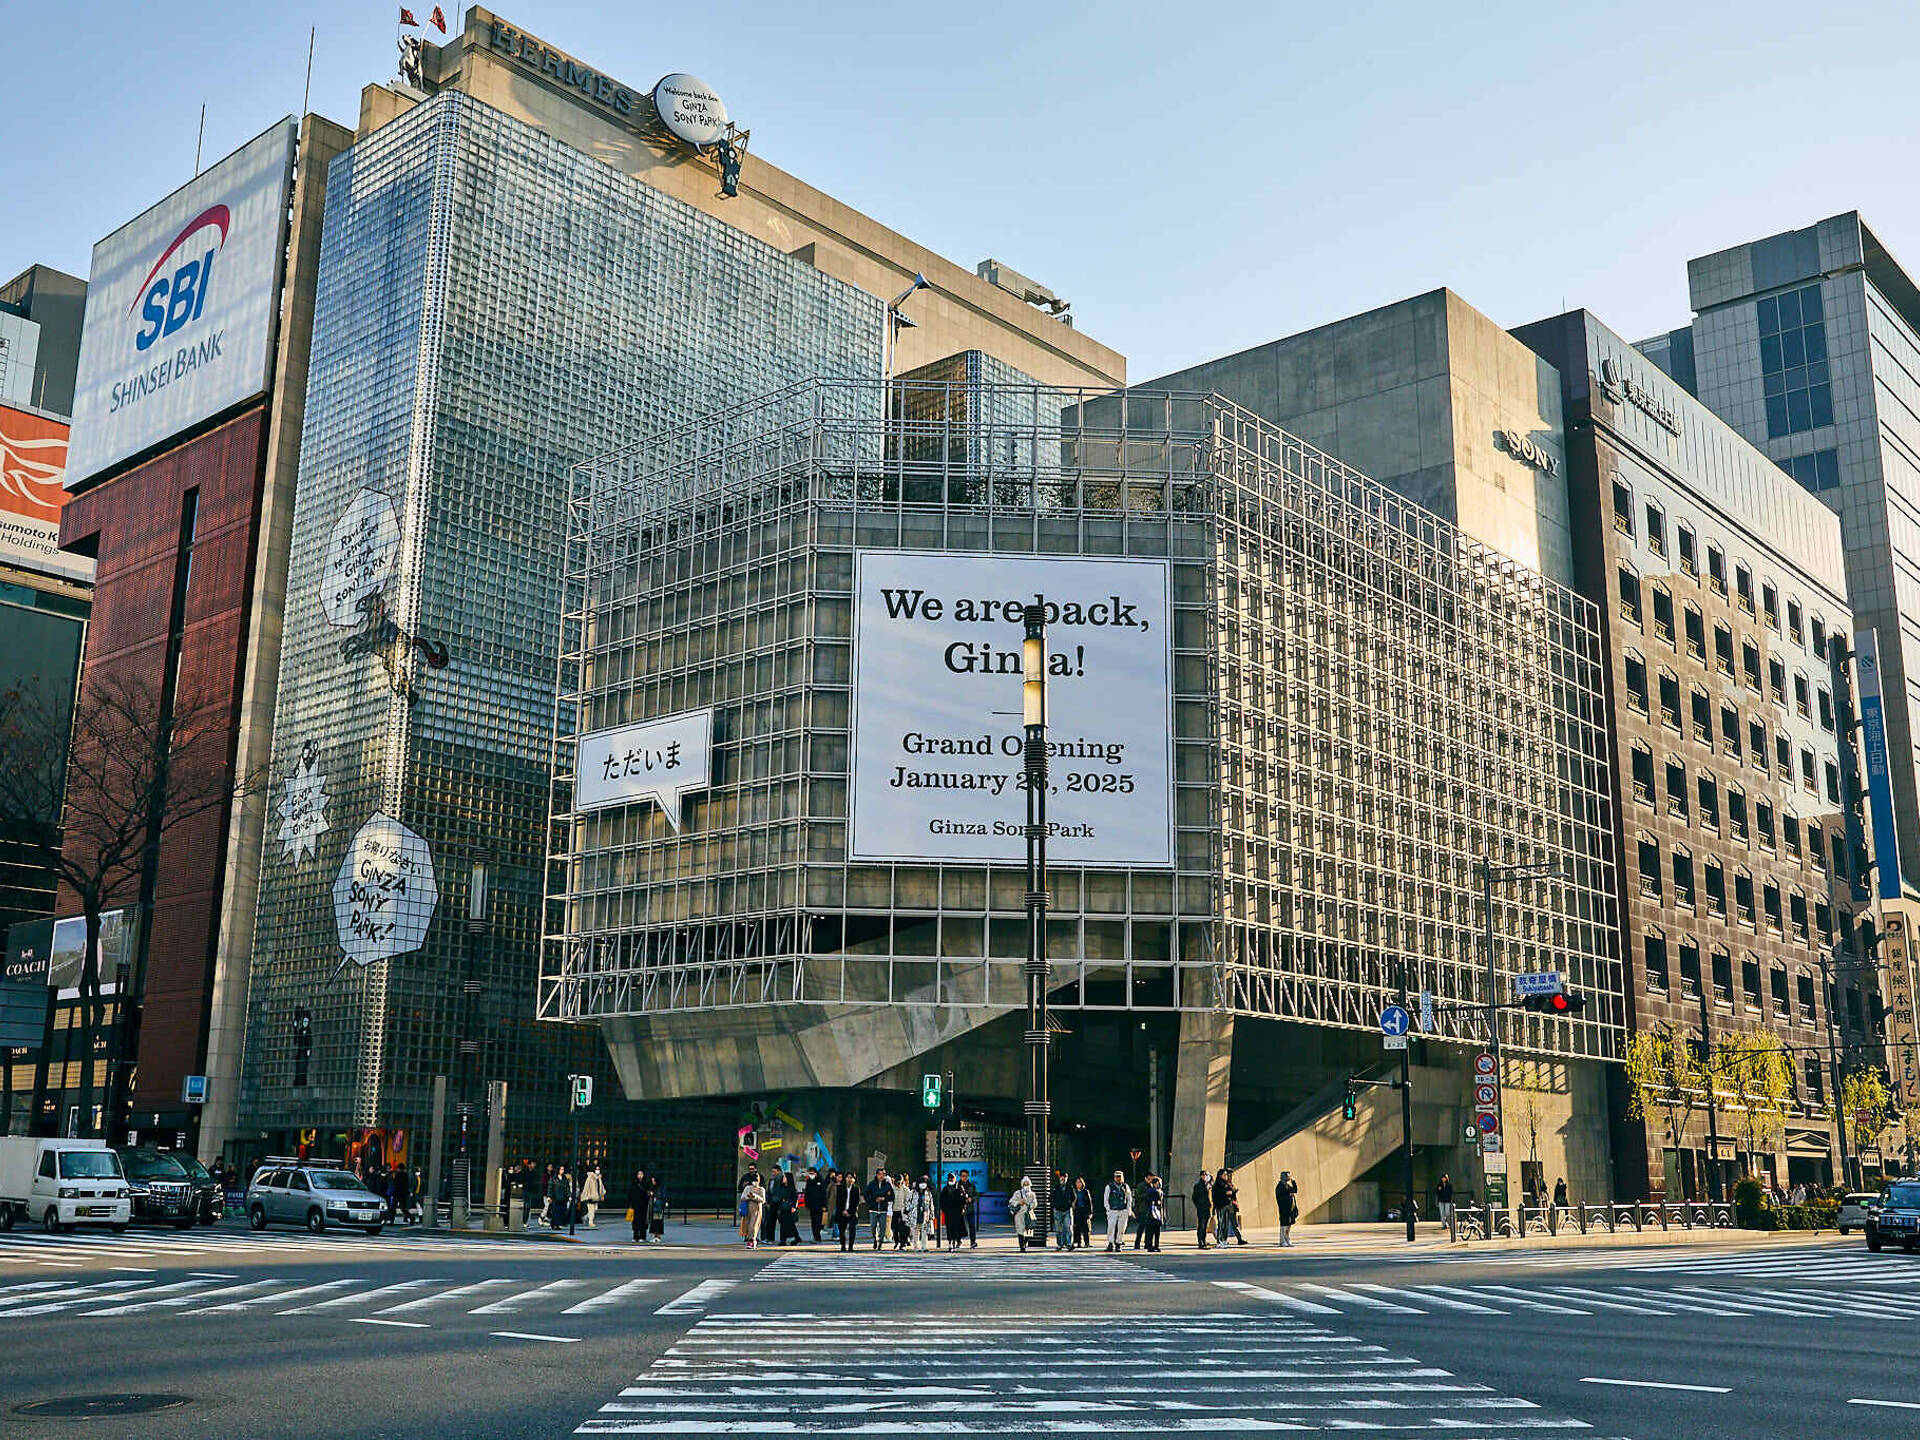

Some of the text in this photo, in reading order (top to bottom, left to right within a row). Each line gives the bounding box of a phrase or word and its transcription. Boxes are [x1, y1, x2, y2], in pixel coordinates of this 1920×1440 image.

[673, 111, 697, 125] SONY
[682, 100, 708, 113] GINZA
[135, 248, 215, 350] SBI
[110, 329, 225, 413] SHINSEI BANK
[1506, 430, 1560, 479] SONY
[1, 532, 60, 555] Holdings
[344, 545, 374, 578] GINZA
[335, 575, 361, 608] SONY
[880, 589, 1150, 632] We are back,
[944, 642, 1085, 677] Gina!
[902, 733, 1124, 764] Grand Oening
[1866, 707, 1885, 776] 東京海上日動
[603, 740, 681, 781] ただいま
[890, 767, 1008, 795] January
[1066, 773, 1135, 794] 2025
[929, 819, 1095, 838] Ginza So Park
[363, 840, 421, 875] お帰りなさい
[360, 859, 406, 896] GINZA
[349, 880, 390, 912] SONY
[350, 910, 395, 943] PARK!
[6, 960, 46, 976] COACH
[941, 1136, 968, 1147] ony
[942, 1148, 967, 1158] ark
